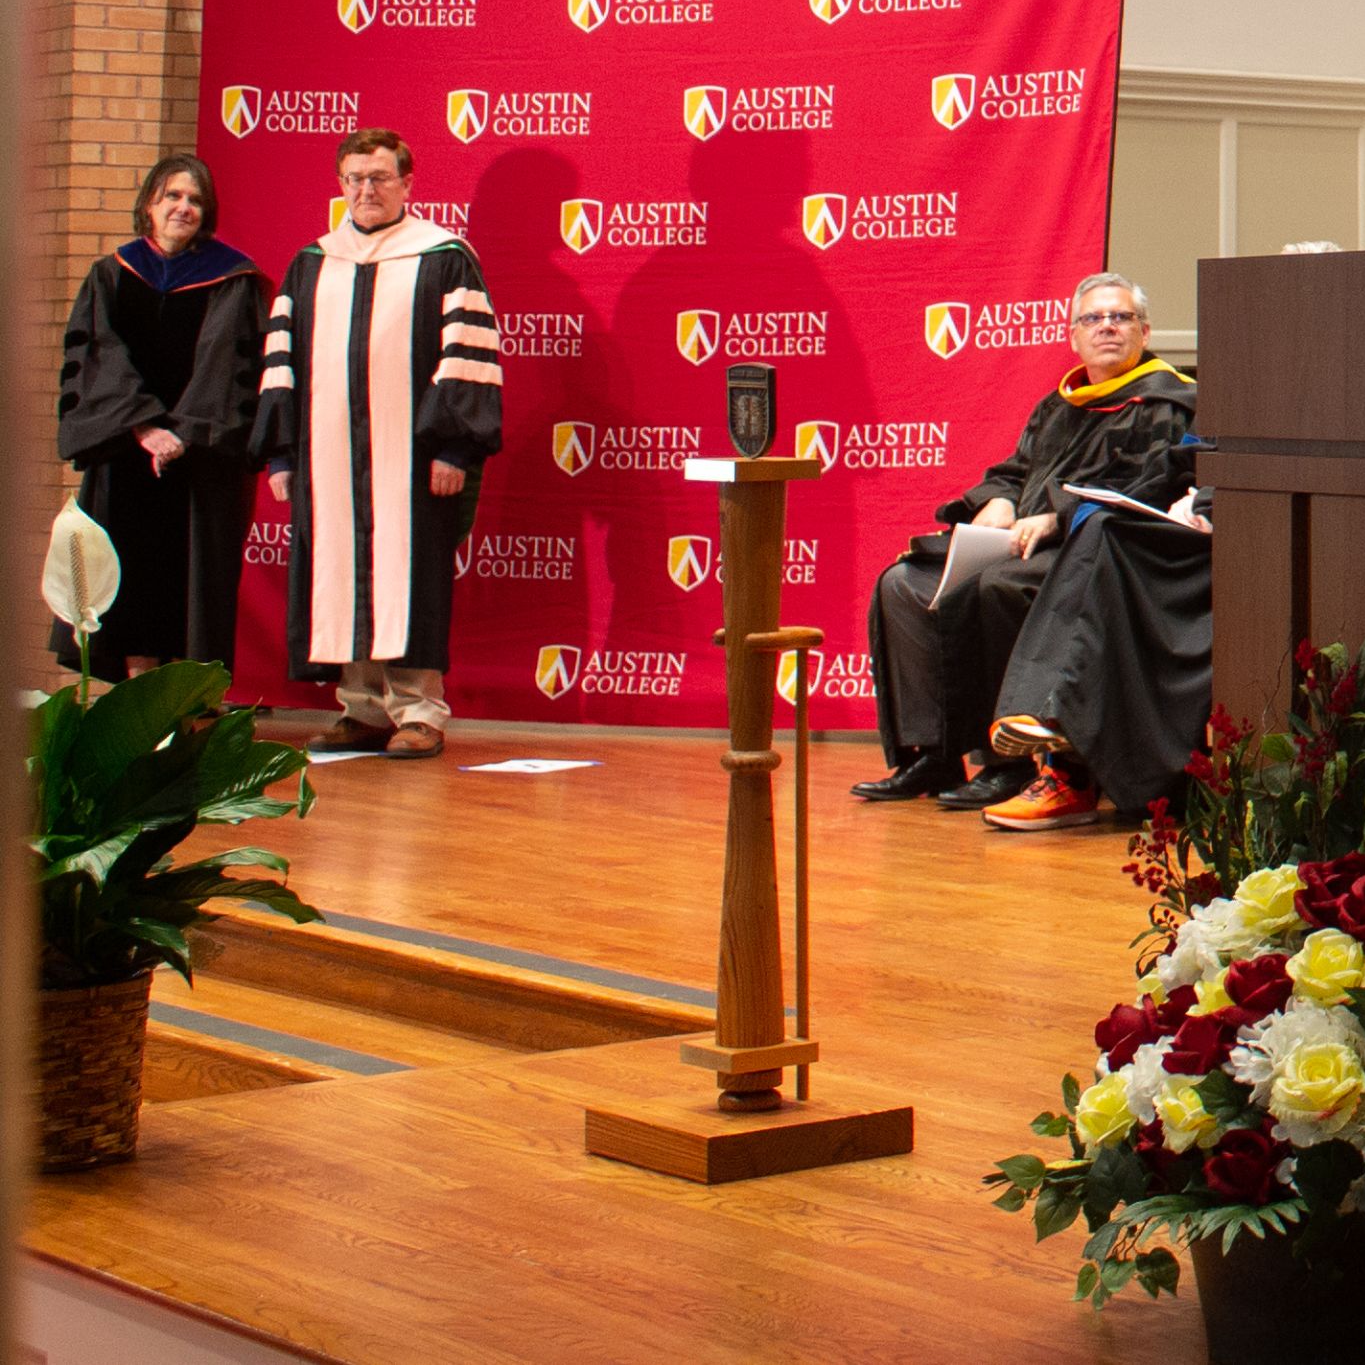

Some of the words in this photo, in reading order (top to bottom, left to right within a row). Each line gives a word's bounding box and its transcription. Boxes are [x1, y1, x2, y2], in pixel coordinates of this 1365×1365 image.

[382, 7, 476, 27] COLLEGE
[615, 3, 714, 25] COLLEGE
[980, 68, 1086, 98] AUSTIN
[266, 90, 360, 114] AUSTIN
[493, 92, 592, 115] AUSTIN
[732, 84, 835, 111] AUSTIN
[980, 92, 1082, 120] COLLEGE
[265, 113, 358, 134] COLLEGE
[493, 116, 590, 136] COLLEGE
[731, 109, 833, 132] COLLEGE
[403, 201, 471, 225] STIN
[607, 202, 708, 226] AUSTIN
[852, 191, 958, 219] AUSTIN
[607, 226, 707, 246] COLLEGE
[852, 217, 957, 240] COLLEGE
[725, 311, 828, 336] AUSTIN
[975, 297, 1071, 328] AUSTIN
[500, 336, 583, 357] OLLEGE
[724, 336, 826, 357] COLLEGE
[975, 322, 1067, 350] COLLEGE
[601, 426, 701, 449] AUSTIN
[844, 421, 949, 447] AUSTIN
[844, 446, 946, 468] COLLEGE
[247, 521, 293, 546] AUS
[477, 535, 575, 559] AUSTIN
[476, 558, 573, 580] COLLEGE
[584, 650, 687, 675] AUSTIN
[581, 674, 682, 696] COLLEGE
